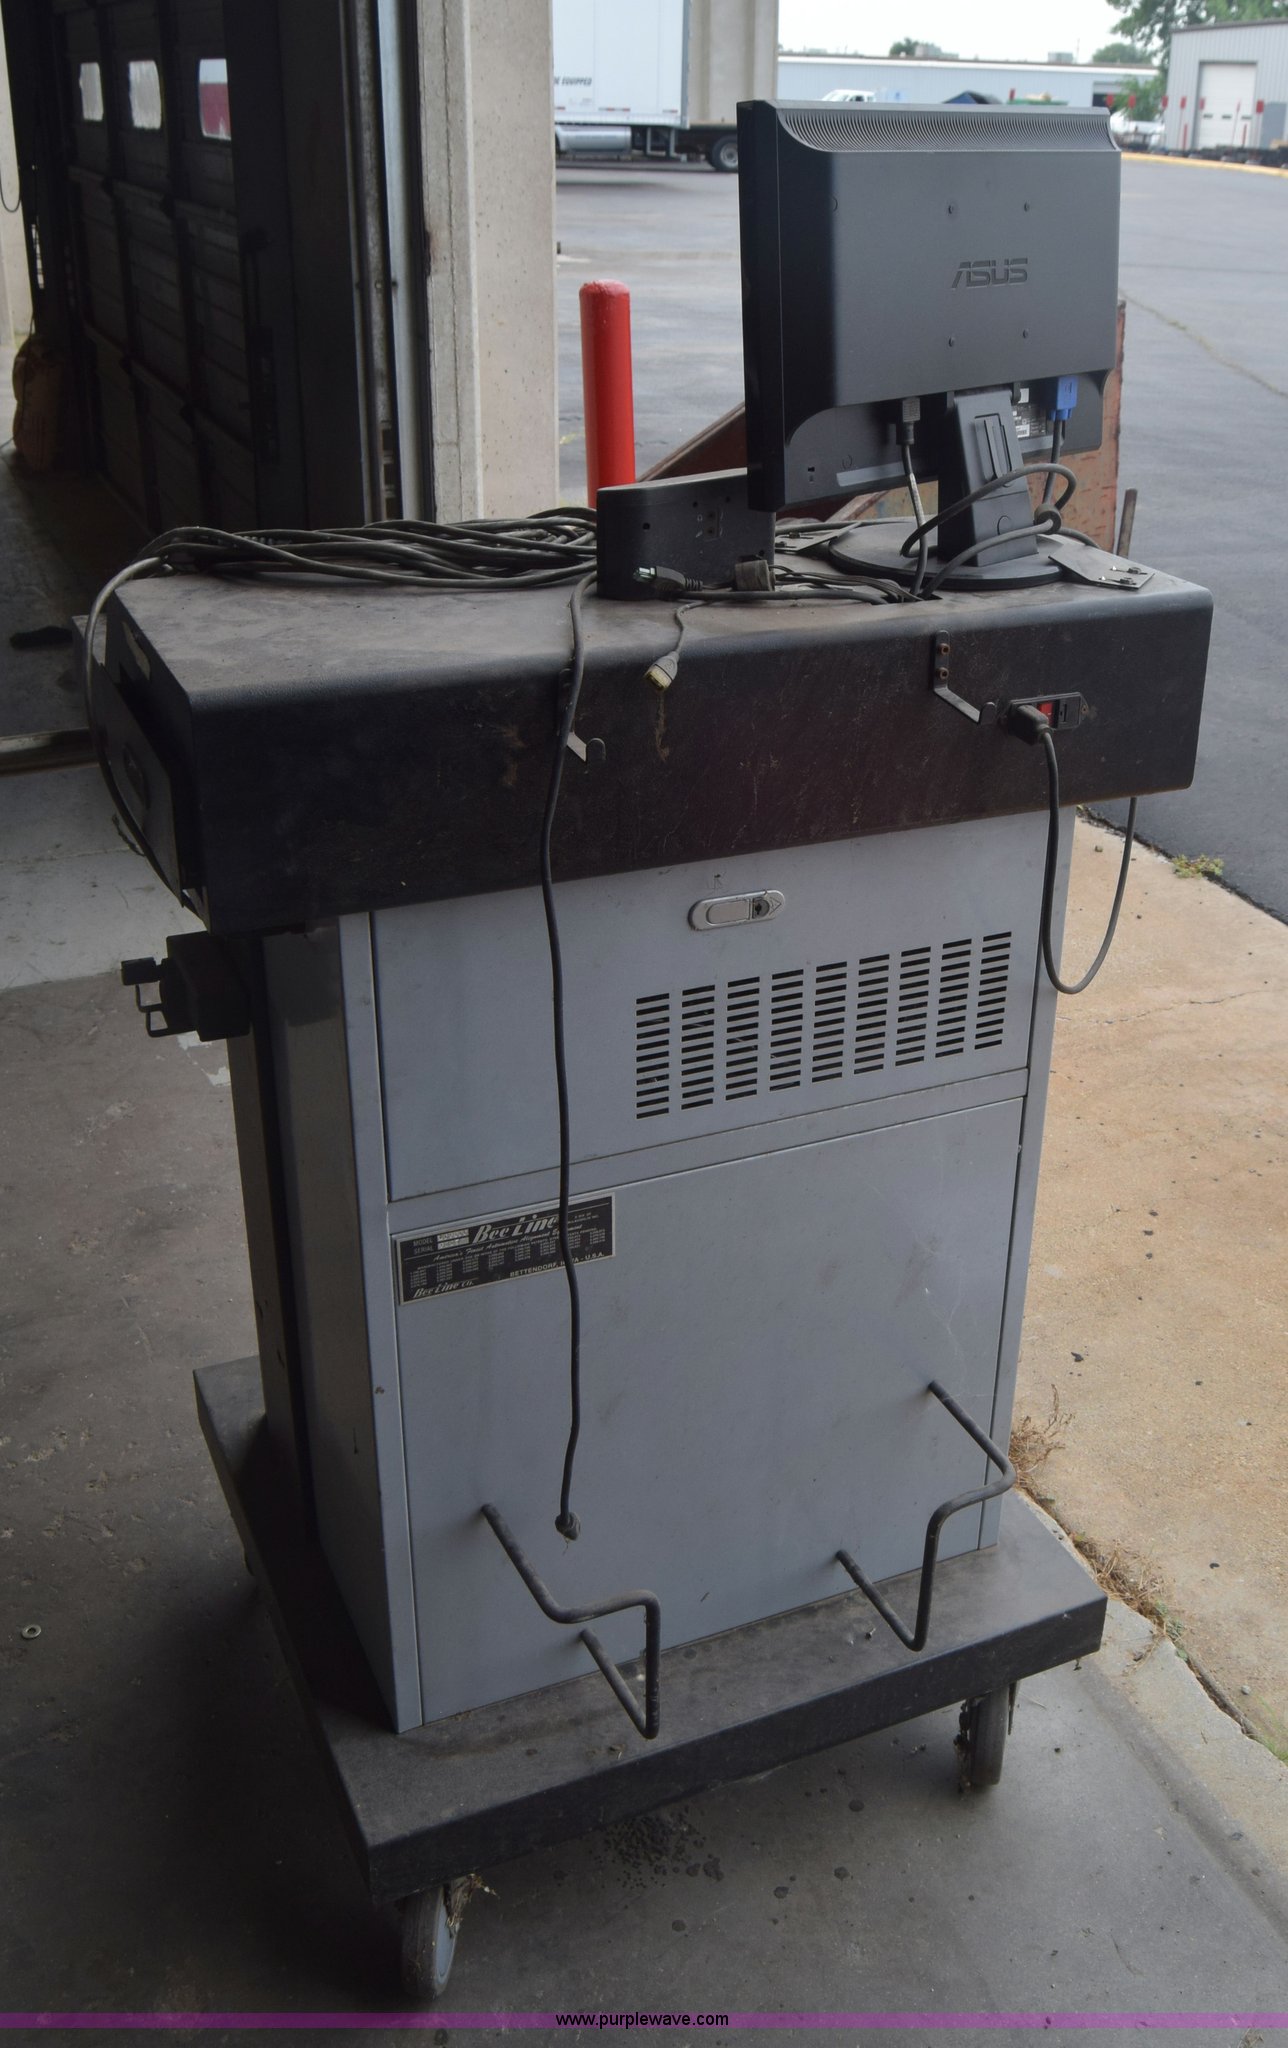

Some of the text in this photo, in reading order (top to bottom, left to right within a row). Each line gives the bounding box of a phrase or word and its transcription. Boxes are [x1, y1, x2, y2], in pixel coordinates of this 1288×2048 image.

[951, 257, 1028, 289] ASUS
[472, 1224, 510, 1244] Bee
[511, 1214, 559, 1237] Line
